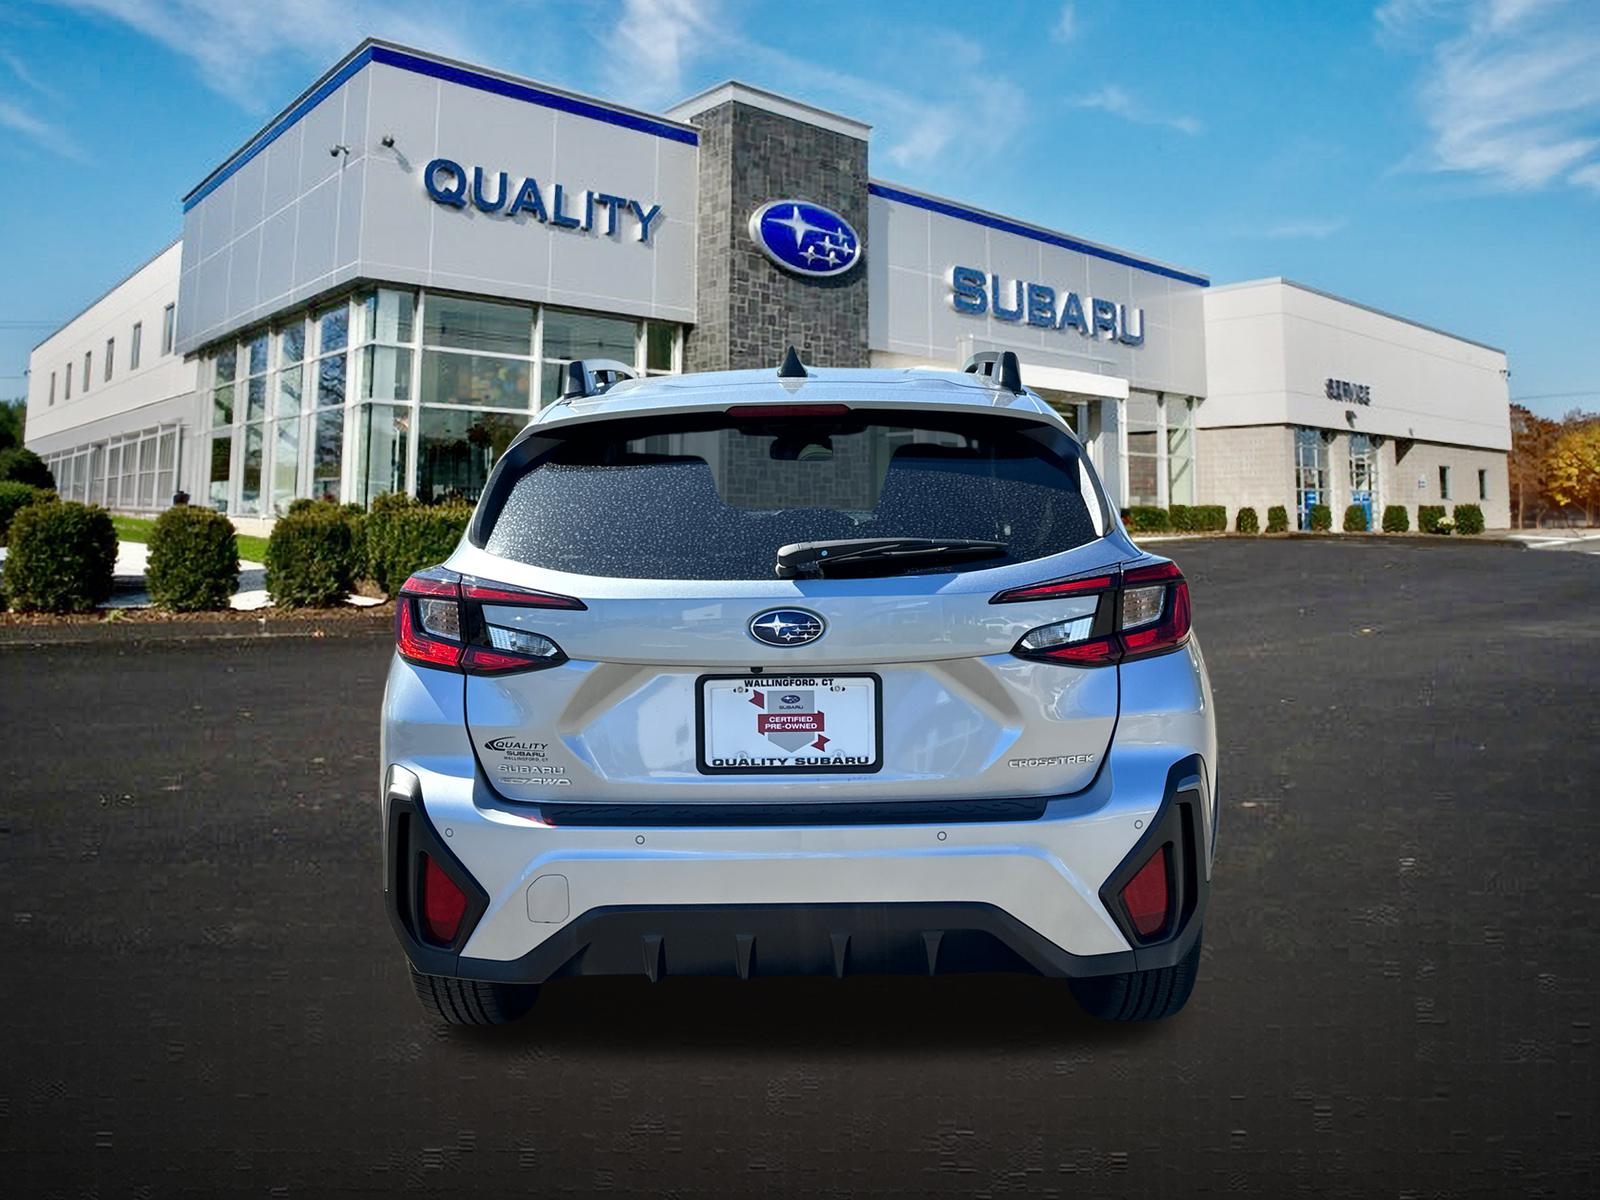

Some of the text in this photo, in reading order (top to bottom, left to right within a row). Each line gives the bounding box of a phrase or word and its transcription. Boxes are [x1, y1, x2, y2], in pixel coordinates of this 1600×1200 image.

[424, 158, 661, 242] QUALITY
[951, 265, 1145, 346] SUBARU
[496, 741, 548, 750] QUALITY
[506, 750, 546, 758] SUBARU
[712, 756, 869, 767] QUALITY SUBARU
[1008, 754, 1095, 768] CROSSTREK
[498, 764, 565, 775] SUBARU
